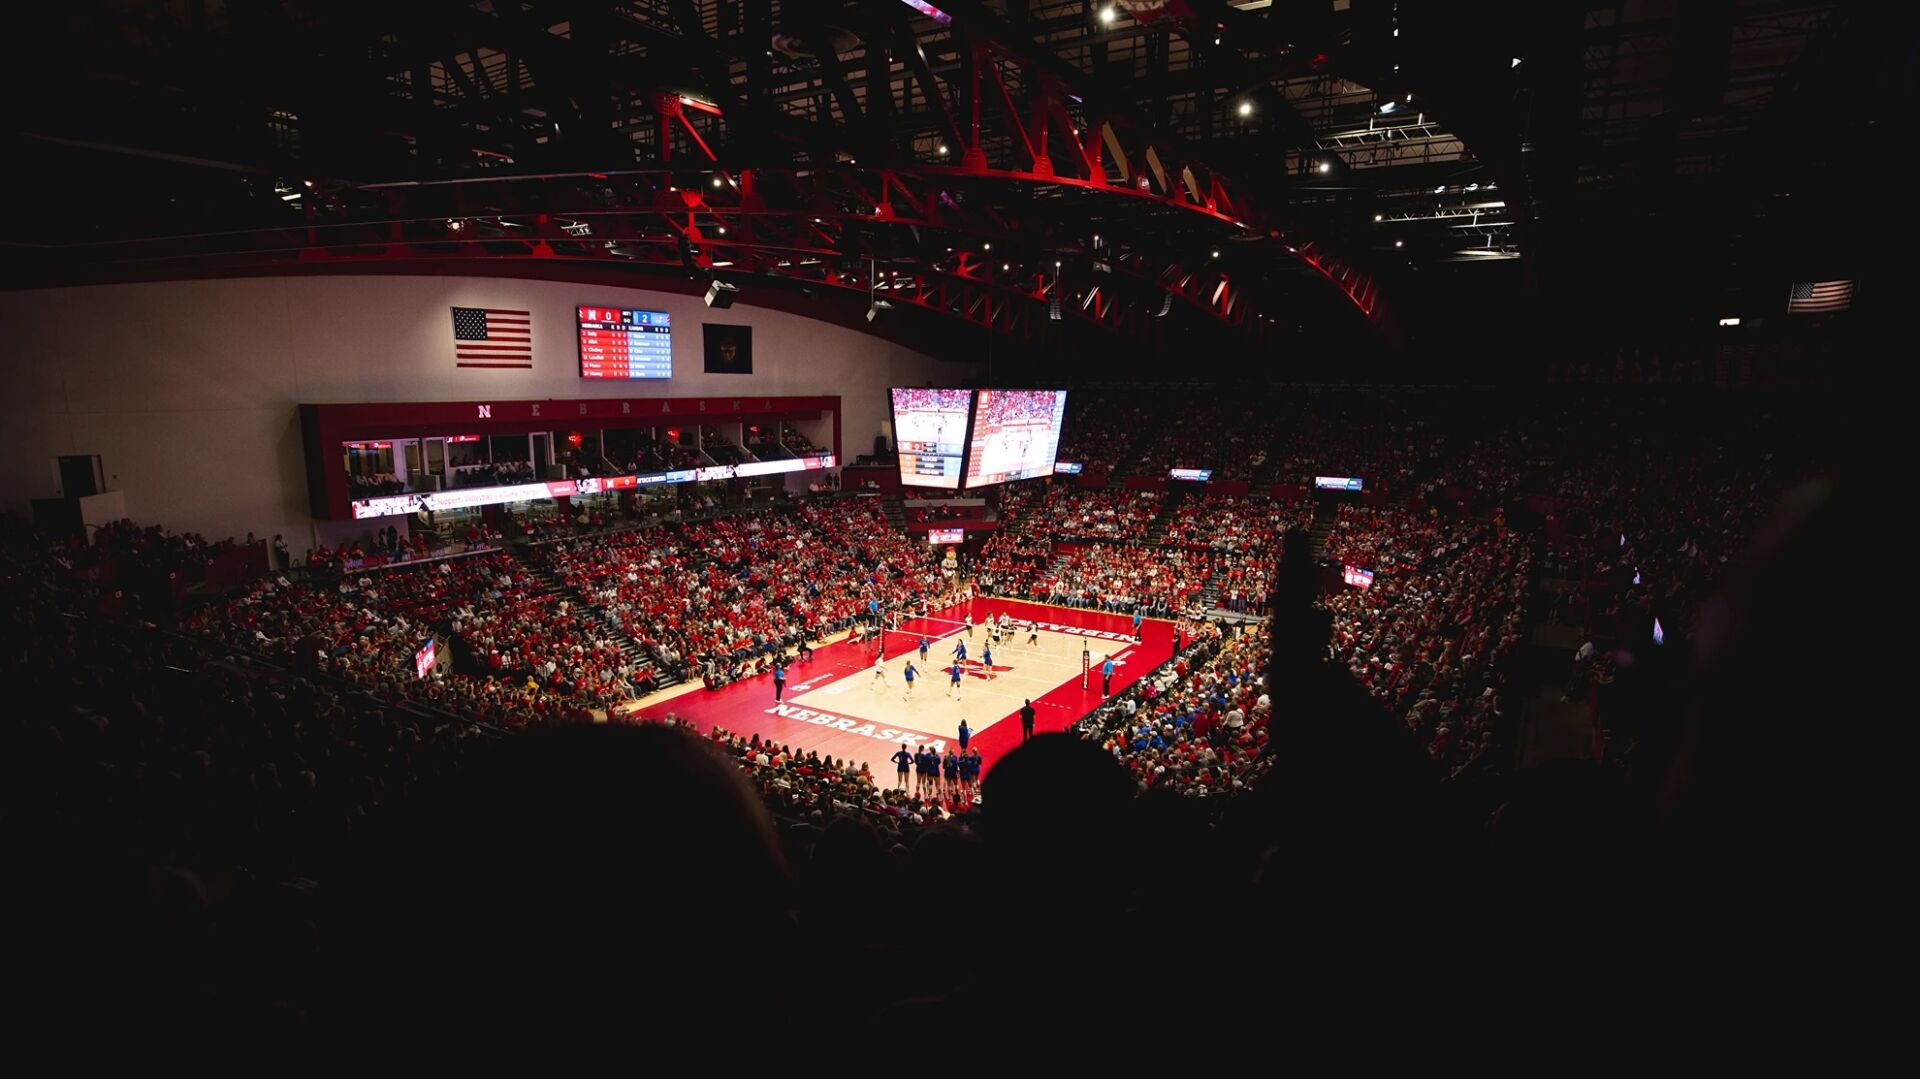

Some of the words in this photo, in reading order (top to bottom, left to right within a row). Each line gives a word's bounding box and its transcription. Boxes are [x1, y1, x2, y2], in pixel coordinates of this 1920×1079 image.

[605, 312, 612, 321] 0
[641, 314, 648, 323] 2
[764, 703, 948, 753] NEBRASKA
